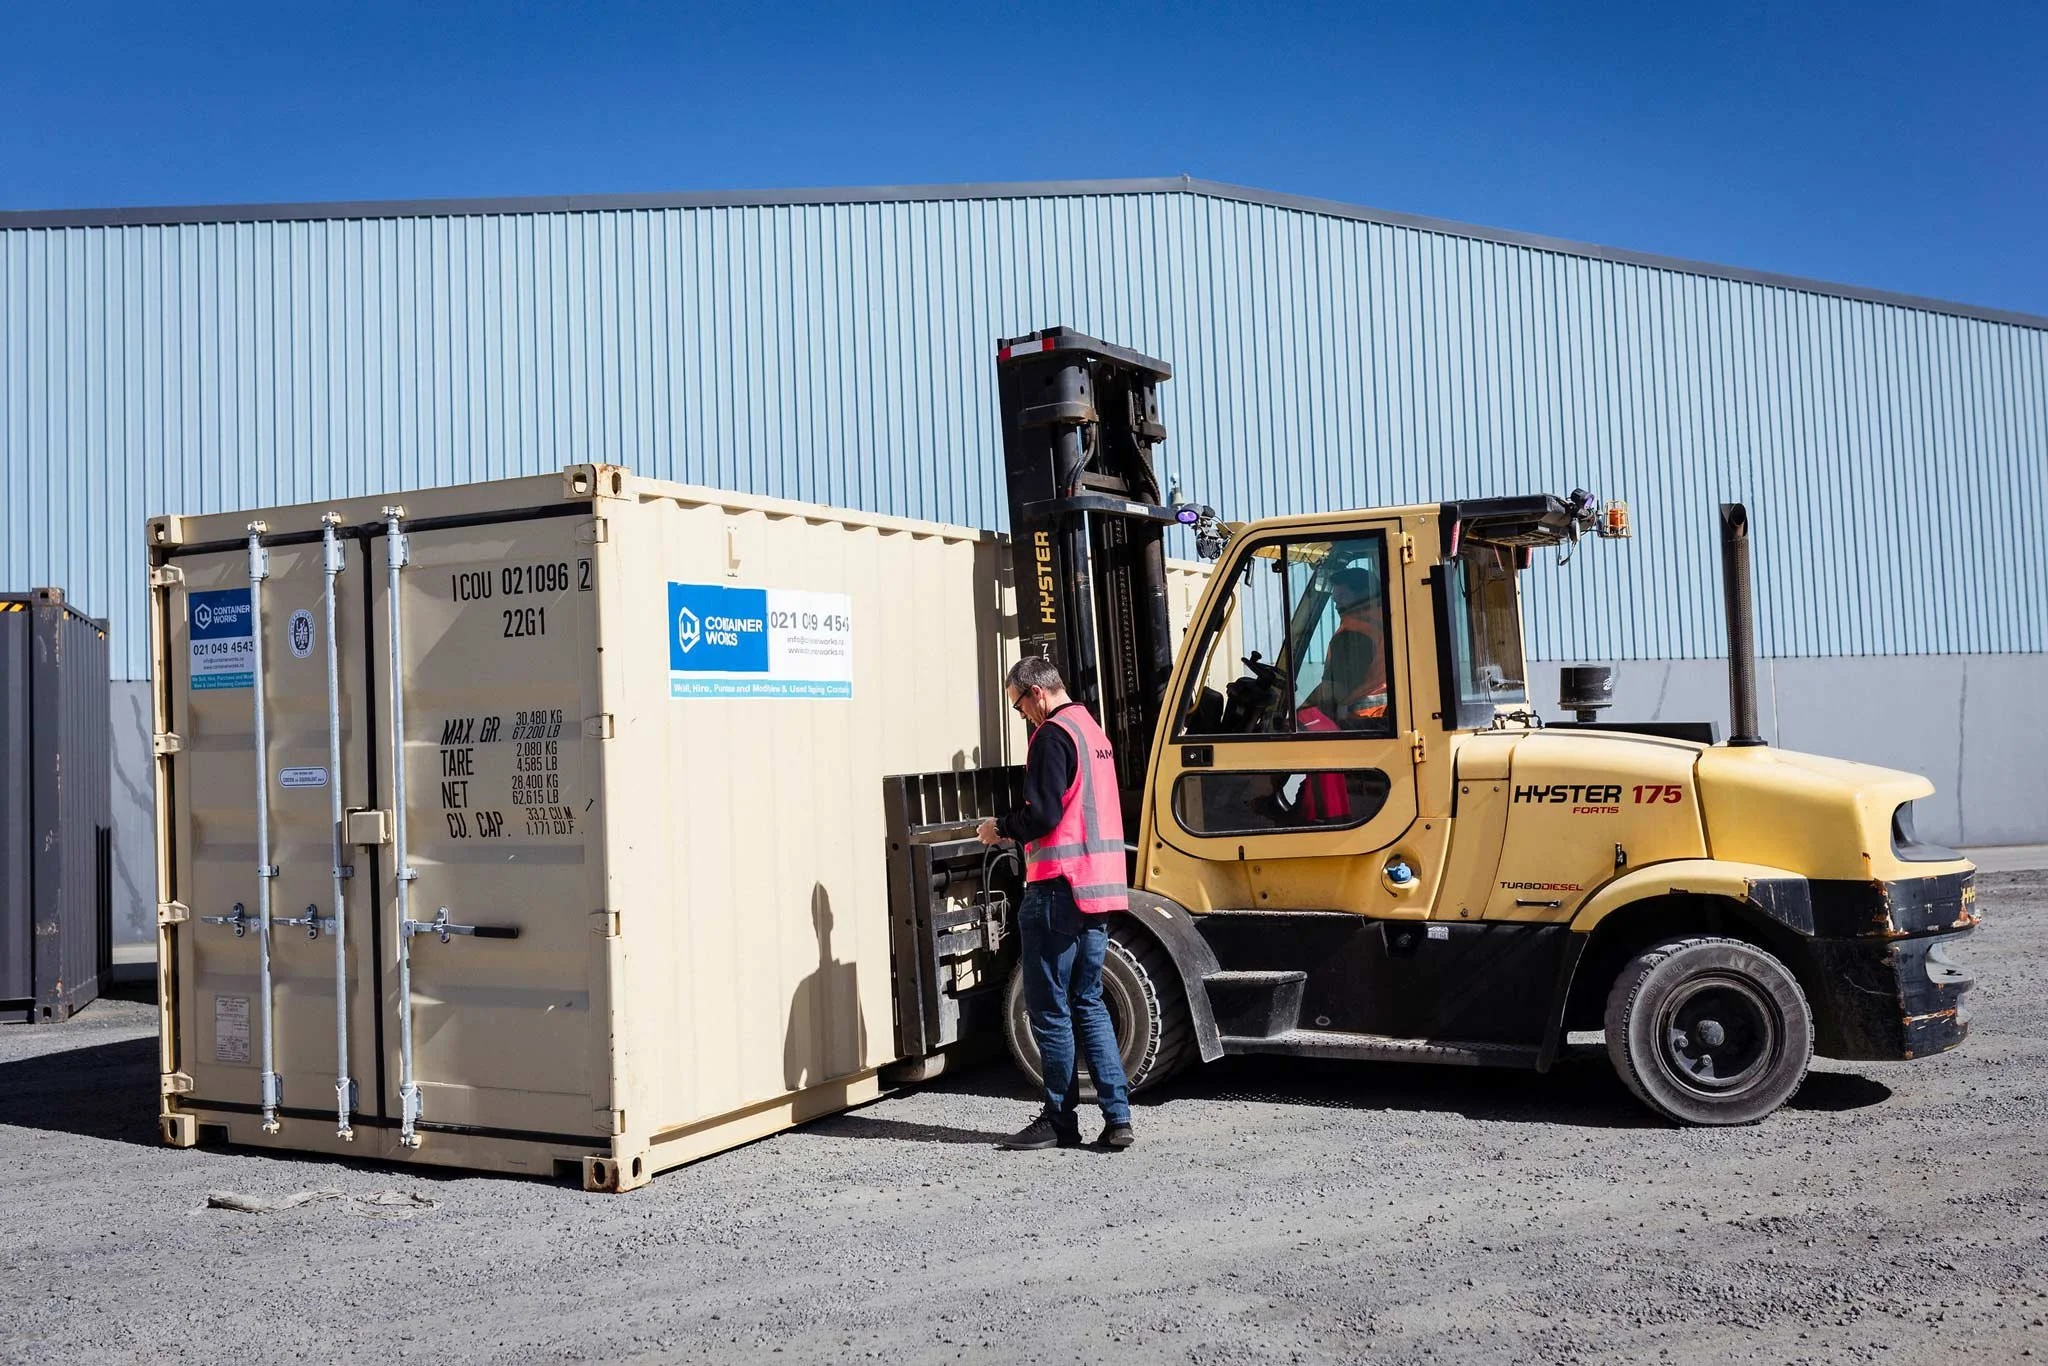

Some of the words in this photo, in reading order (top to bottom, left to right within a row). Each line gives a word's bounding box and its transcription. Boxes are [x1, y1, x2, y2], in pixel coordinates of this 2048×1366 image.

[452, 570, 492, 602] ICOU
[502, 562, 569, 595] 021096
[579, 560, 591, 590] 2
[1034, 531, 1057, 624] HYSTER
[213, 604, 251, 616] CONTAINER
[213, 614, 238, 624] WORKS
[503, 606, 545, 638] 22G1
[770, 611, 798, 629] 021
[802, 612, 818, 631] 09
[193, 644, 209, 656] 021
[211, 642, 228, 654] 049
[440, 718, 475, 746] MAX.
[479, 716, 502, 743] GR.
[515, 710, 547, 727] 30,480
[550, 709, 563, 725] KG
[547, 724, 561, 738] LB
[440, 748, 475, 777] TARE
[516, 742, 542, 758] 2,080
[545, 741, 558, 756] KG
[516, 757, 543, 773] 4,585
[545, 756, 558, 771] LB
[441, 780, 469, 809] NET
[511, 775, 543, 790] 28,400
[546, 774, 559, 789] KG
[512, 790, 544, 806] 62,615
[547, 789, 559, 804] LB
[1513, 784, 1623, 804] HYSTER
[1632, 784, 1682, 804] 175
[1573, 806, 1619, 814] FORTIS
[446, 812, 472, 839] CU.
[525, 807, 548, 821] 33.2
[1500, 881, 1584, 892] TURBODIESEL
